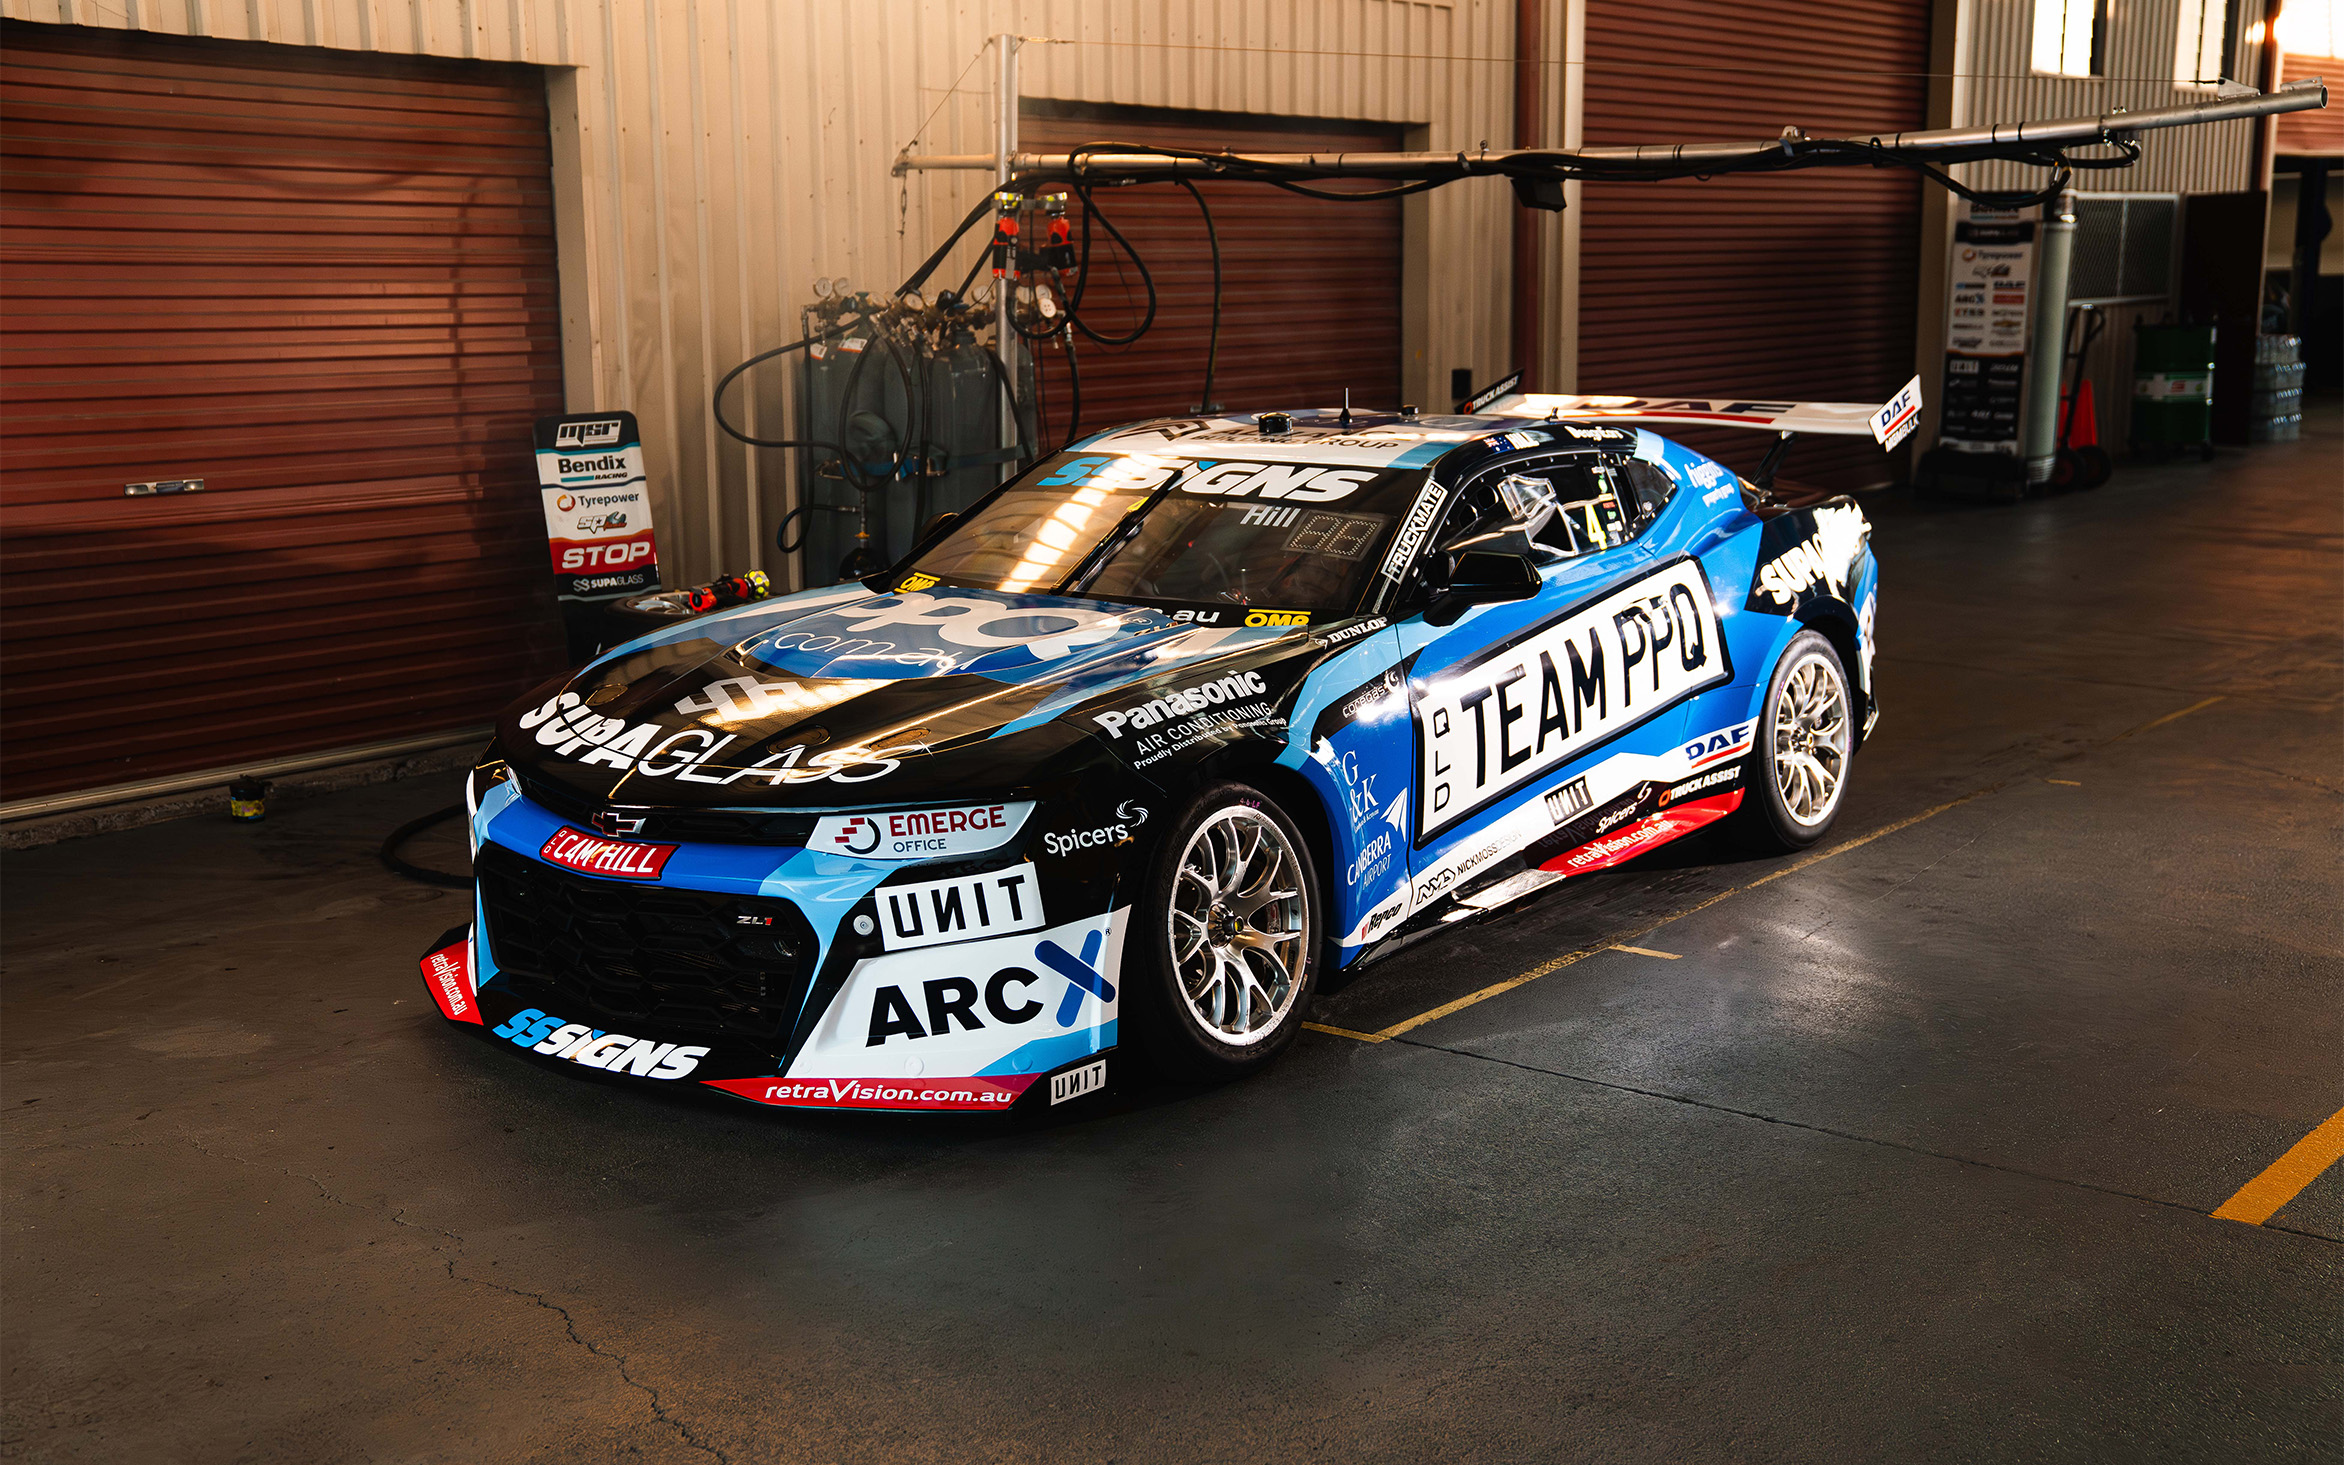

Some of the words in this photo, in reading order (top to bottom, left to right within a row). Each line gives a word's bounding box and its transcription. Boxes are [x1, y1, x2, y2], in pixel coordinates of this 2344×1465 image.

[1881, 389, 1911, 428] DAF
[558, 455, 626, 474] Bendix
[594, 472, 628, 481] RACING
[578, 492, 639, 508] Tyrepower
[1240, 504, 1302, 528] Hill
[1388, 482, 1444, 578] TRUCKMATE
[1585, 504, 1607, 550] 4
[562, 542, 650, 569] STOP
[899, 575, 936, 592] OMP
[1244, 612, 1310, 628] OMP
[1328, 616, 1389, 644] DUNLOP
[1461, 627, 1607, 789] TEAM
[1612, 583, 1708, 708] PPQ
[1092, 670, 1267, 740] Panasonic
[1133, 747, 1173, 770] Proudly
[1171, 728, 1223, 752] Distributed
[1222, 722, 1233, 733] by
[1136, 733, 1169, 755] AIR
[1167, 702, 1272, 740] CONDITIONING
[1685, 725, 1750, 761] DAF
[1343, 750, 1358, 787] G
[1547, 780, 1589, 821] UNIT
[1596, 802, 1638, 833] Spicers
[889, 806, 1006, 837] EMERGE
[554, 834, 592, 867] C4M
[595, 842, 659, 873] HILL
[893, 838, 947, 853] OFFICE
[1044, 823, 1129, 857] Spicers
[1347, 830, 1391, 886] CANBERRA
[1362, 854, 1391, 891] AIRPORT
[737, 915, 773, 926] ZL1
[889, 874, 1026, 939] UNIT
[1368, 903, 1403, 934] Repco
[430, 953, 467, 1016] retraVision.com.au
[765, 1079, 1012, 1103] retraVision.com.au
[1055, 1064, 1103, 1099] UNIT
